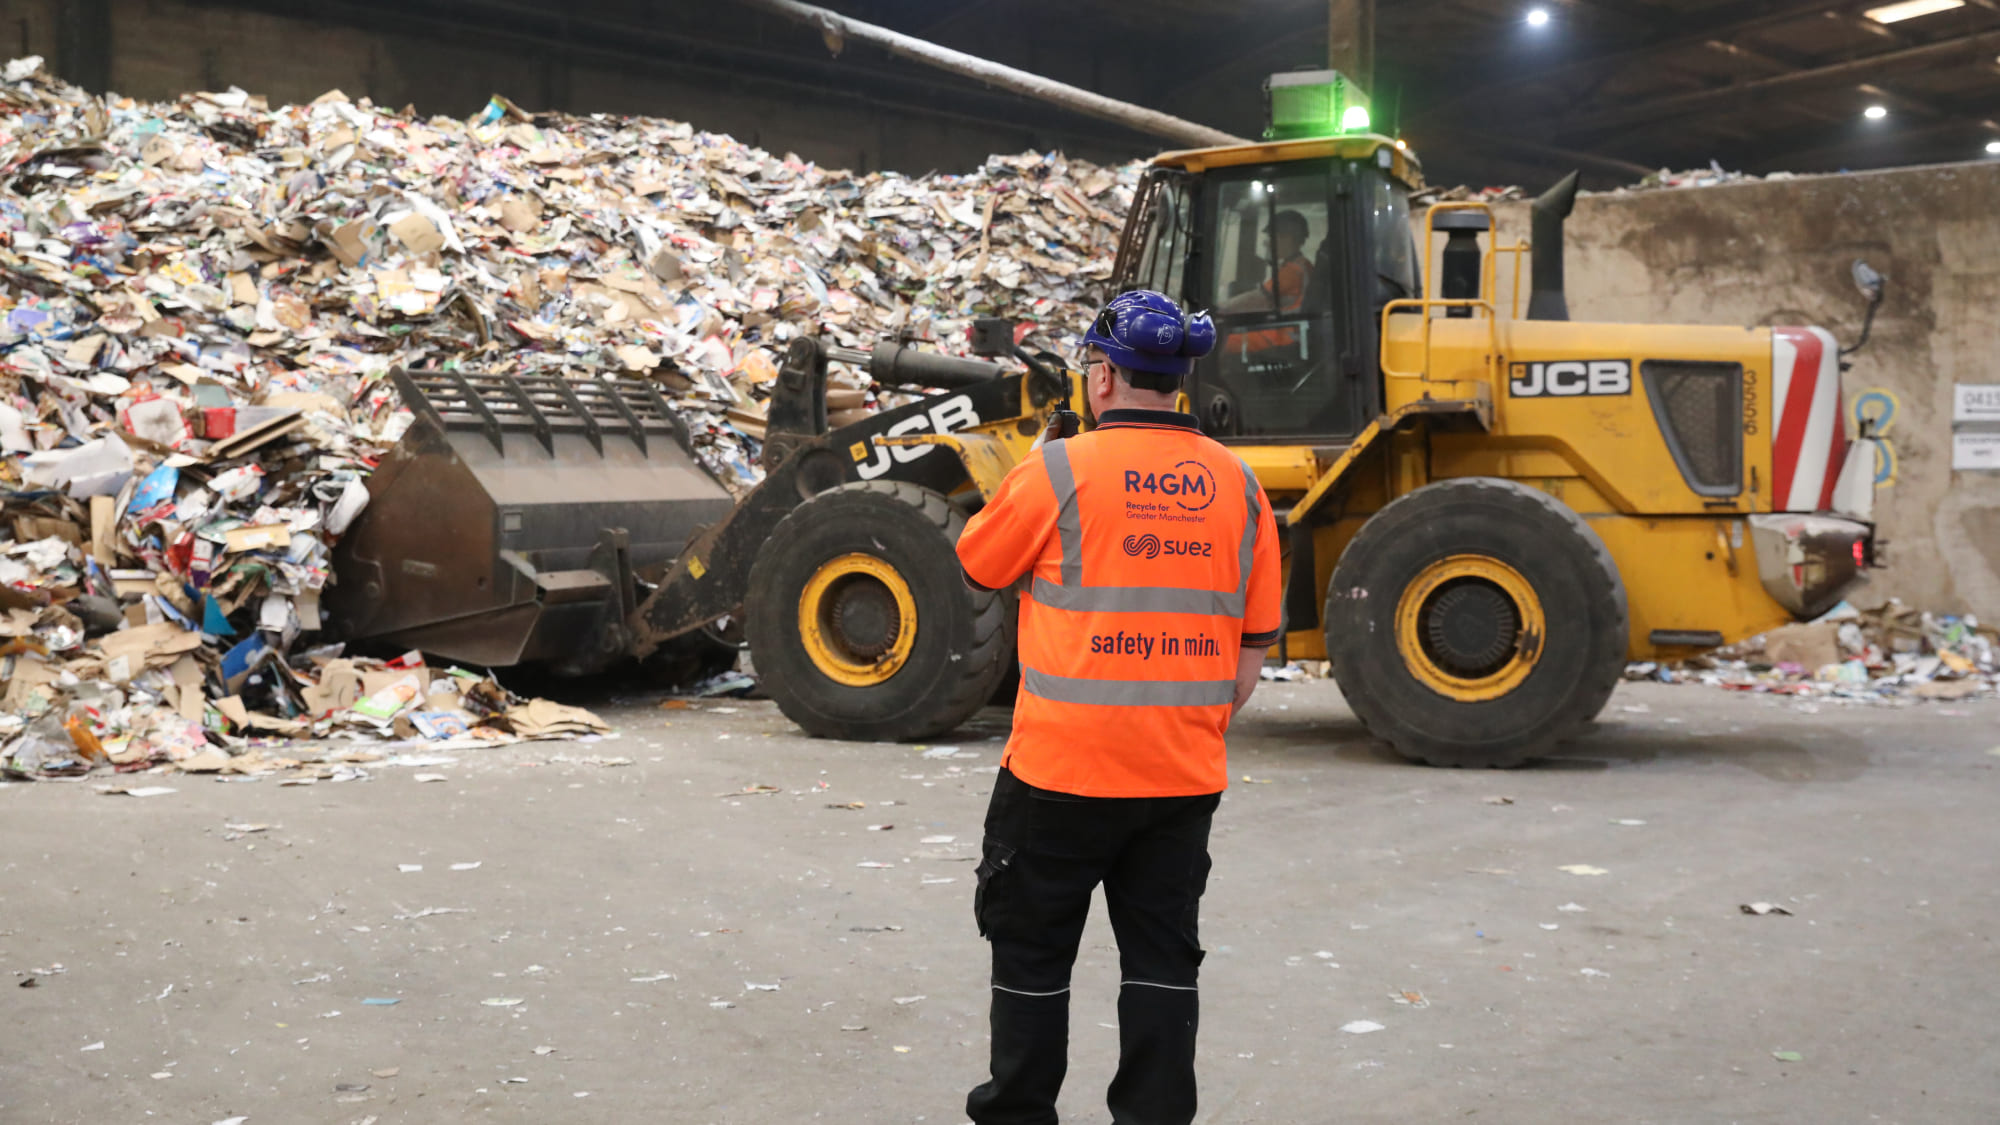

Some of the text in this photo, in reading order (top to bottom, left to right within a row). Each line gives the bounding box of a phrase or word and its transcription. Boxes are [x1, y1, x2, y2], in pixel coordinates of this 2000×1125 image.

[1510, 360, 1631, 397] JCB
[856, 394, 981, 480] JCB
[1124, 469, 1207, 497] R4GM
[1126, 501, 1170, 513] Recycle for
[1126, 511, 1206, 523] Greater Manchester
[1091, 631, 1155, 660] safety
[1161, 632, 1180, 656] in
